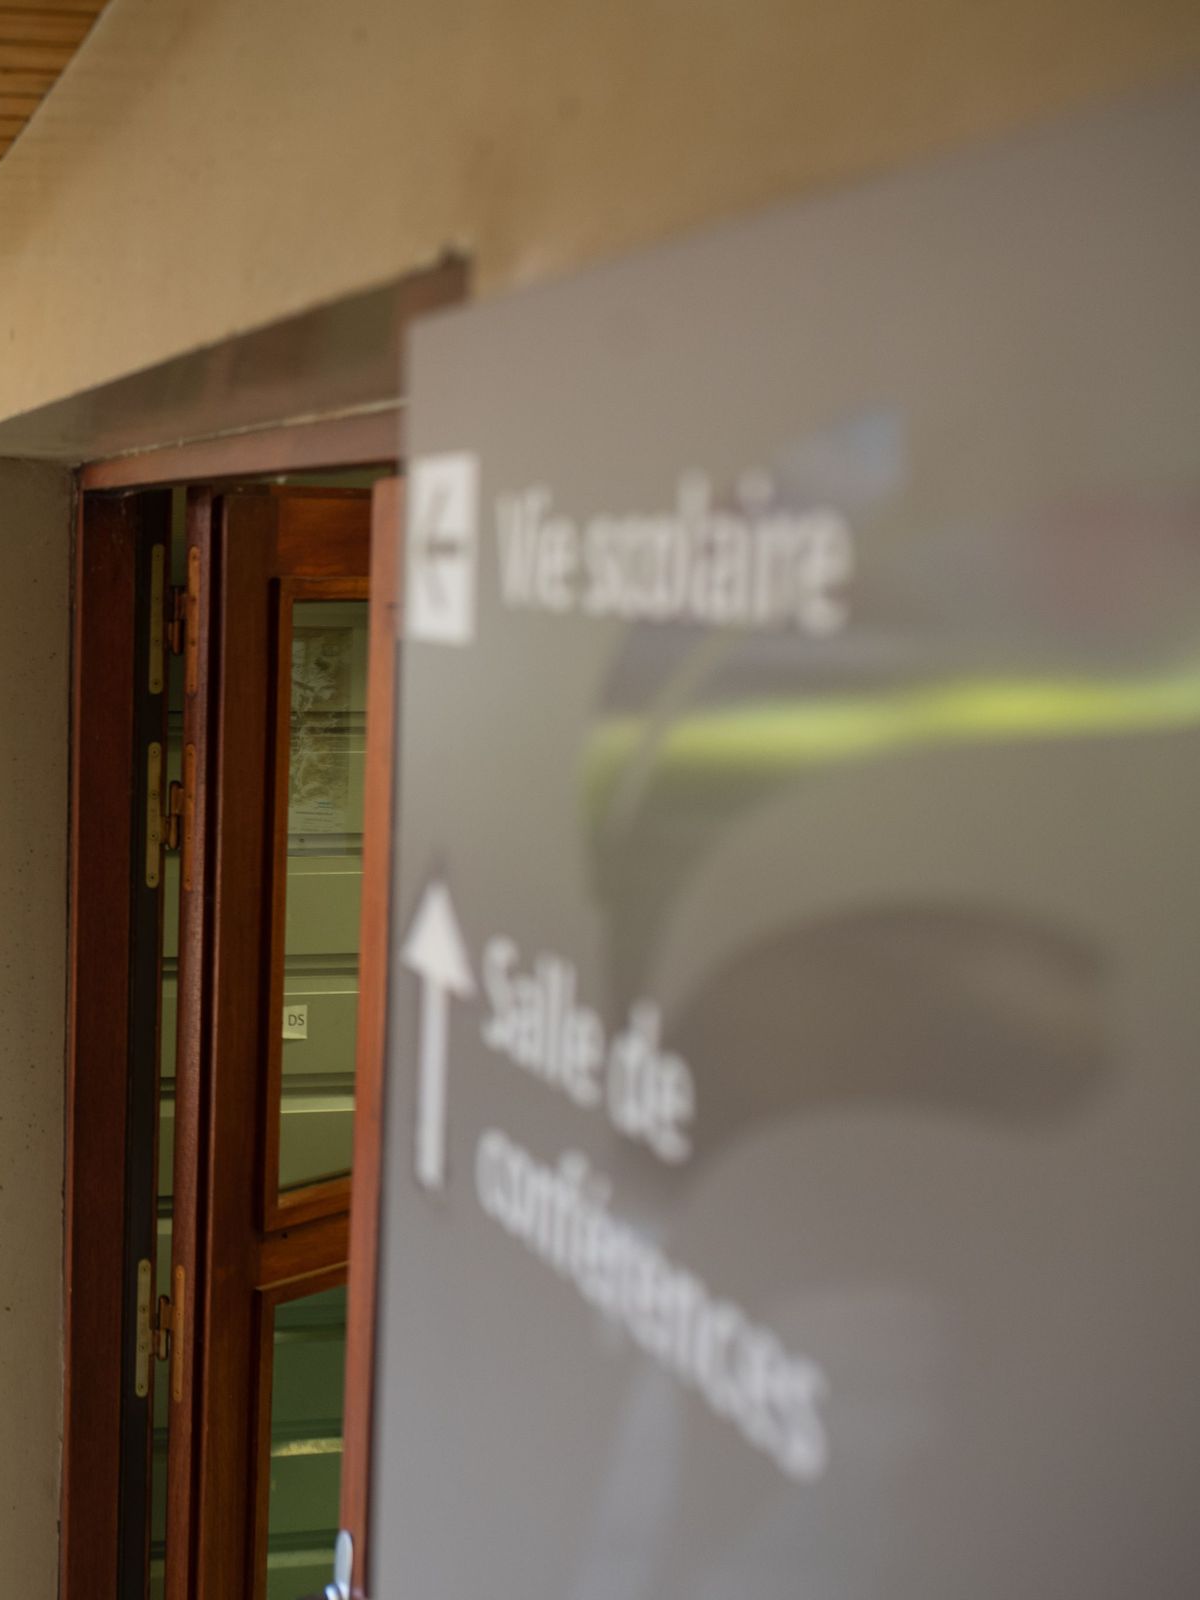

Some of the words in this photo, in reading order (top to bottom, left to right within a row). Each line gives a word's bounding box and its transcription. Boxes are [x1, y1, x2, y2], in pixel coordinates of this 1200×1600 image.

[582, 464, 855, 638] scolaire
[288, 1014, 305, 1026] DS
[480, 932, 603, 1107] Salle
[607, 996, 694, 1164] de
